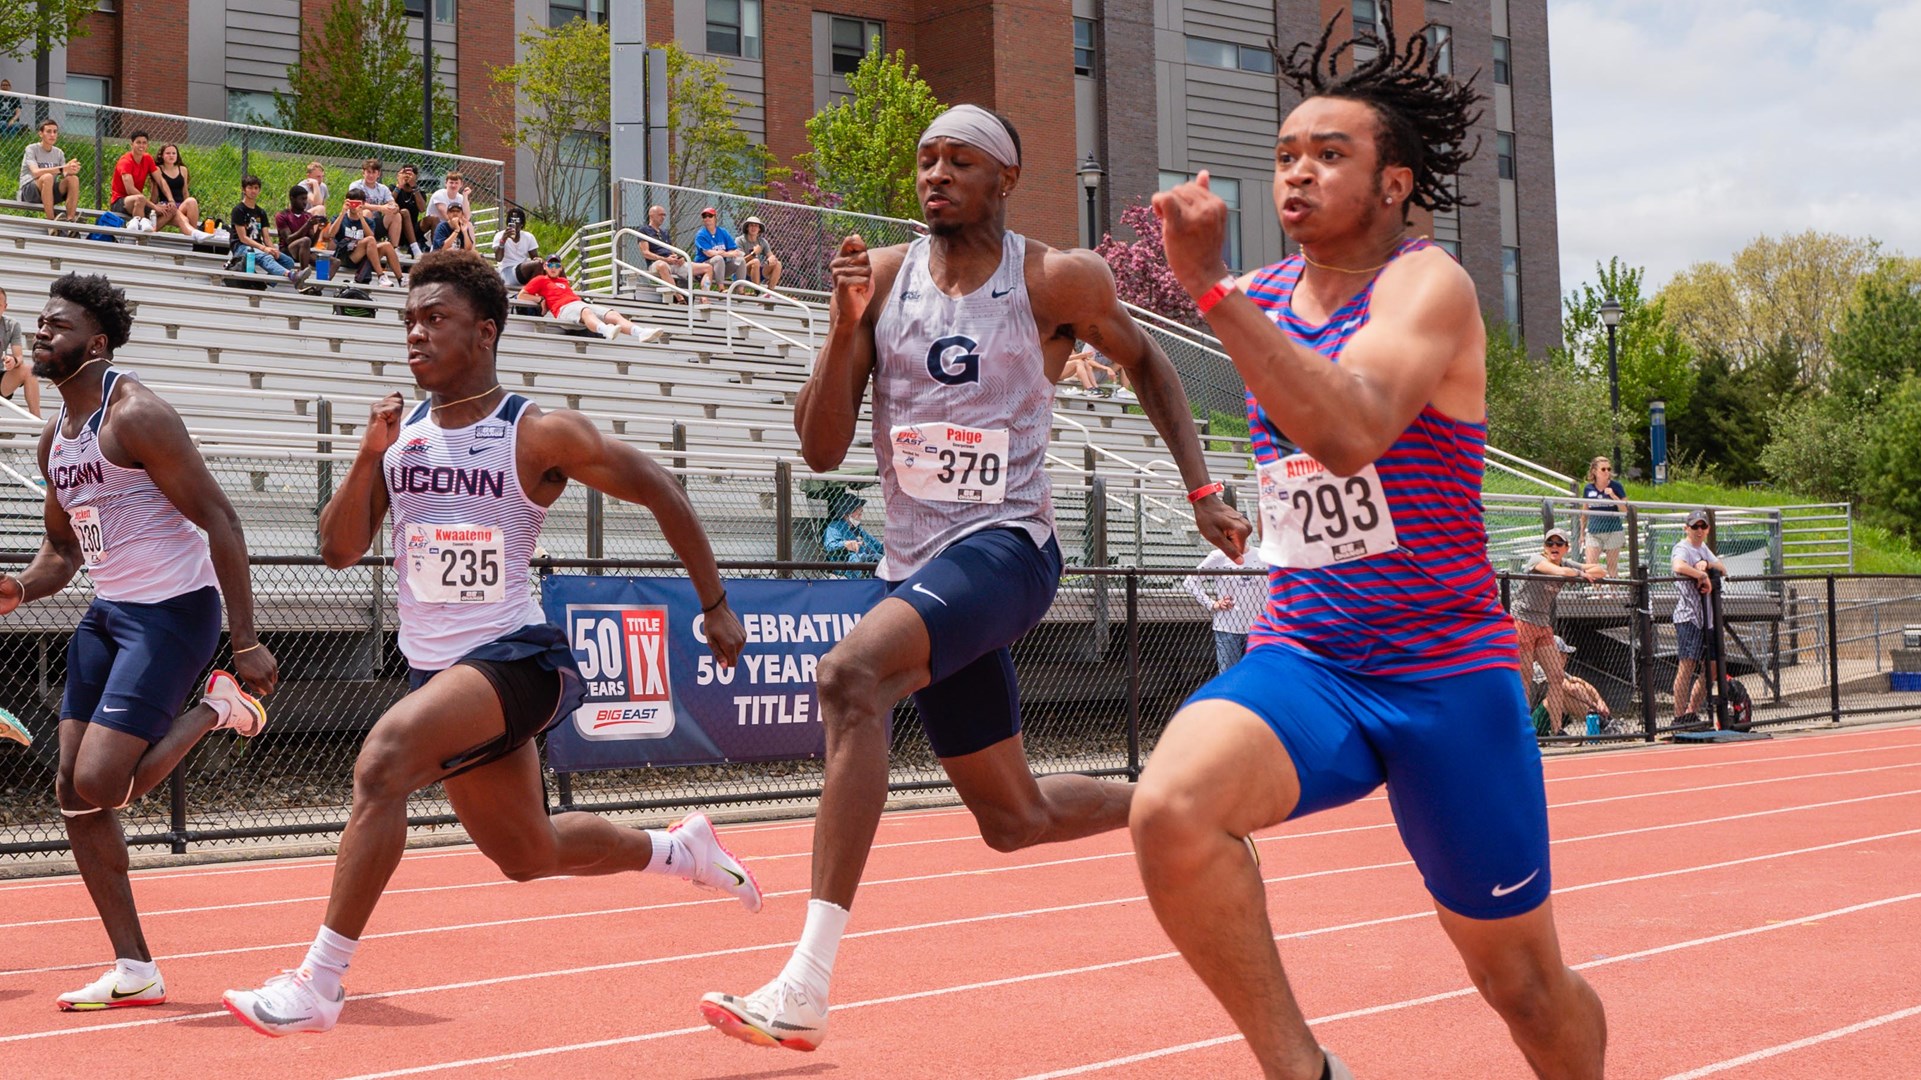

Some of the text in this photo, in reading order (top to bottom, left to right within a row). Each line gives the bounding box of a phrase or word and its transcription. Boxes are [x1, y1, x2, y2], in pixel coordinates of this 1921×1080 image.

[926, 335, 980, 386] G
[896, 438, 922, 446] EAST
[946, 427, 982, 444] Paige
[390, 465, 504, 498] UCONN
[937, 449, 1000, 486] 370
[1292, 476, 1379, 544] 293
[435, 528, 492, 542] Kwaateng
[440, 549, 499, 587] 235
[626, 617, 660, 632] TITLE
[692, 613, 863, 644] CEBRATIN
[575, 617, 623, 680] 50
[628, 634, 665, 695] IX
[697, 653, 828, 685] 50 YEAR
[596, 708, 658, 720] BIG EAST
[733, 694, 810, 726] TITLE
